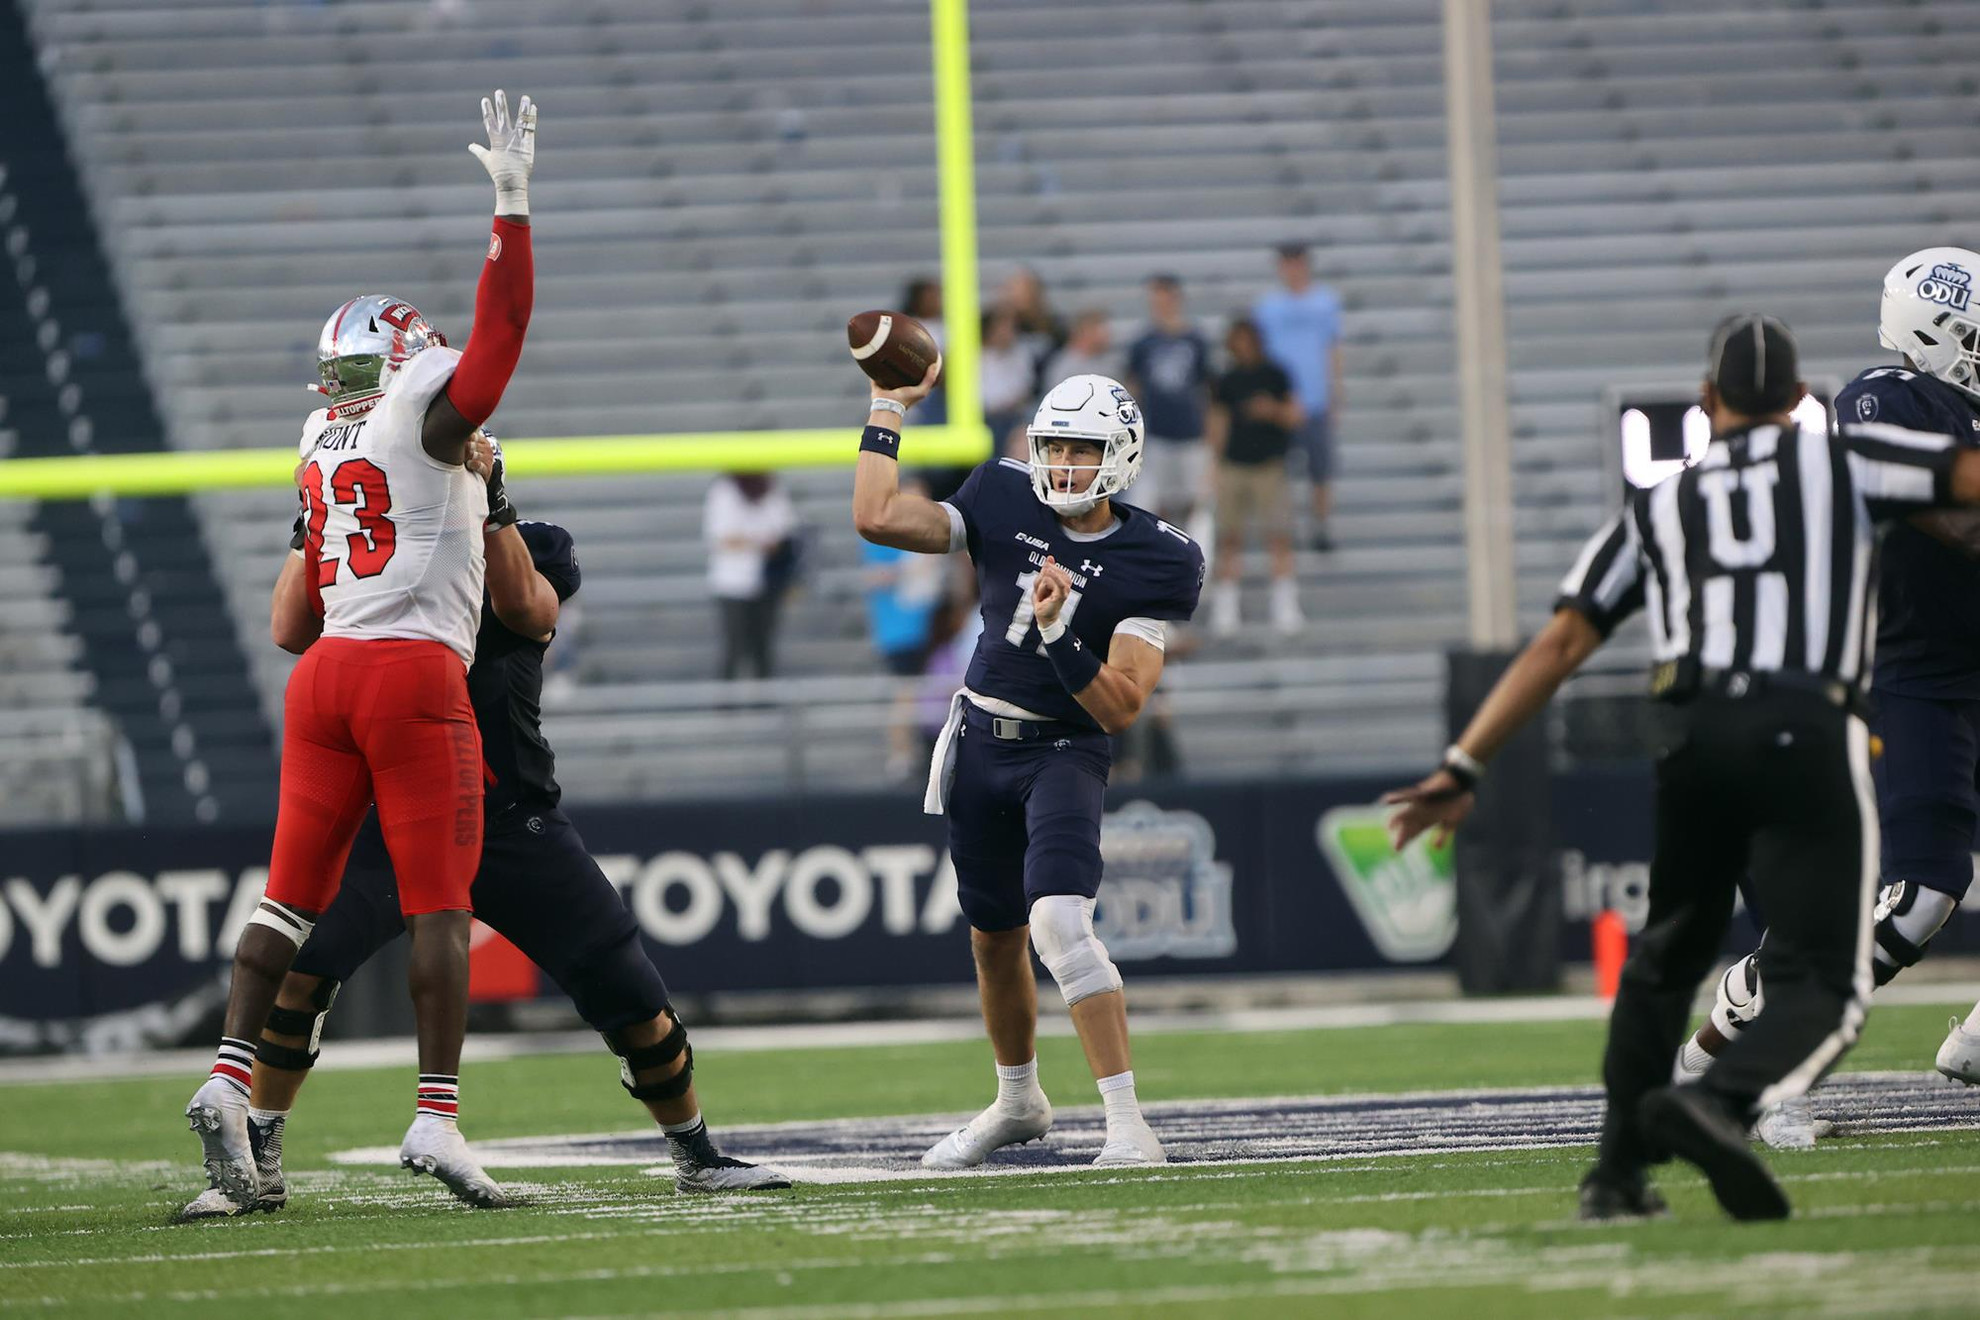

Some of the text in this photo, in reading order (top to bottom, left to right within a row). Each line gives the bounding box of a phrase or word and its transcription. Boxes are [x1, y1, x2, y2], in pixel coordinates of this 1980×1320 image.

[1917, 277, 1971, 311] ODU
[1697, 459, 1779, 570] U
[1028, 551, 1047, 568] OLD
[0, 867, 269, 968] YOT
